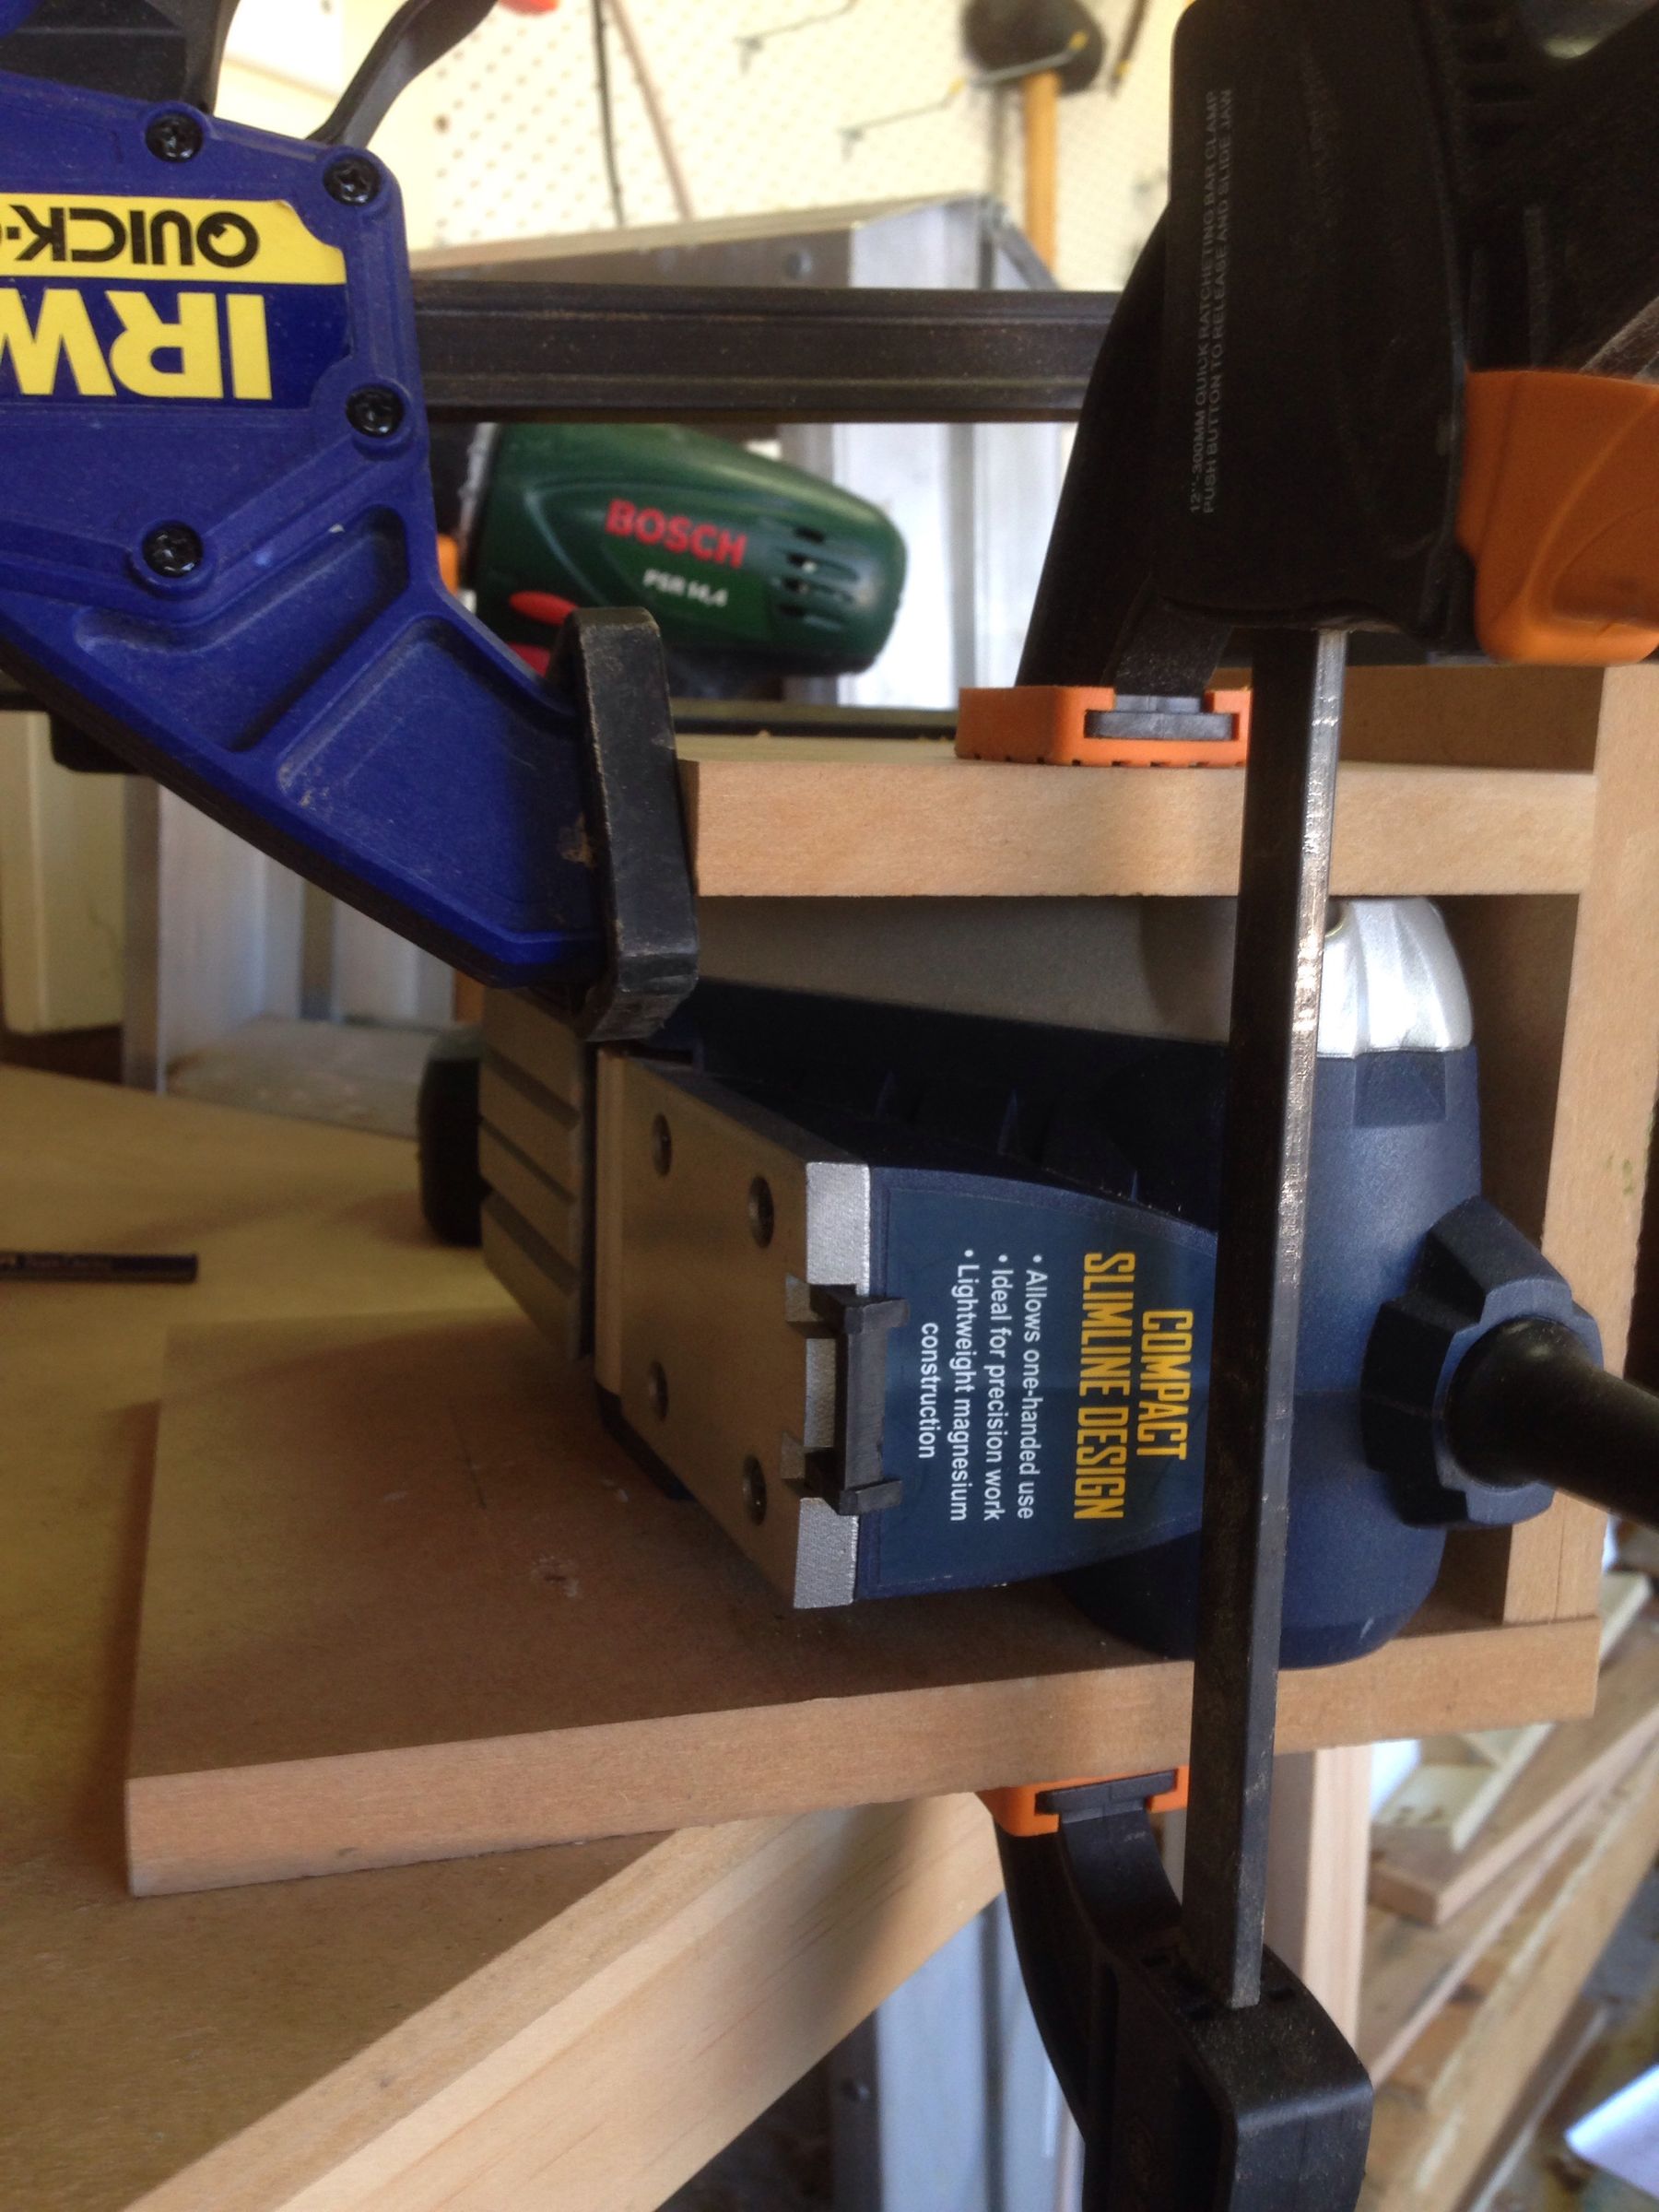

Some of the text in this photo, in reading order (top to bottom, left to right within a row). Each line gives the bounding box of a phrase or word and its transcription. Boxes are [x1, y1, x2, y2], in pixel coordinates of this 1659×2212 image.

[1203, 163, 1216, 206] BAR
[1204, 89, 1218, 159] CLAMP
[0, 204, 260, 268] QUICK-
[1198, 209, 1216, 339] RATCHETING
[1202, 89, 1232, 513] PUSH BUTTON TO RELEASE AND SLIDE JAW
[1195, 343, 1209, 406] QUICK
[605, 498, 747, 569] BOSCH
[918, 1322, 942, 1459] construction
[947, 1264, 980, 1521] Lightweight magnesium
[983, 1269, 1014, 1521] Ideal for precision work
[1017, 1269, 1048, 1519] Allows one-handed use
[1074, 1252, 1136, 1519] SLIMLINE DESIGN
[1135, 1310, 1194, 1461] COMPACT
